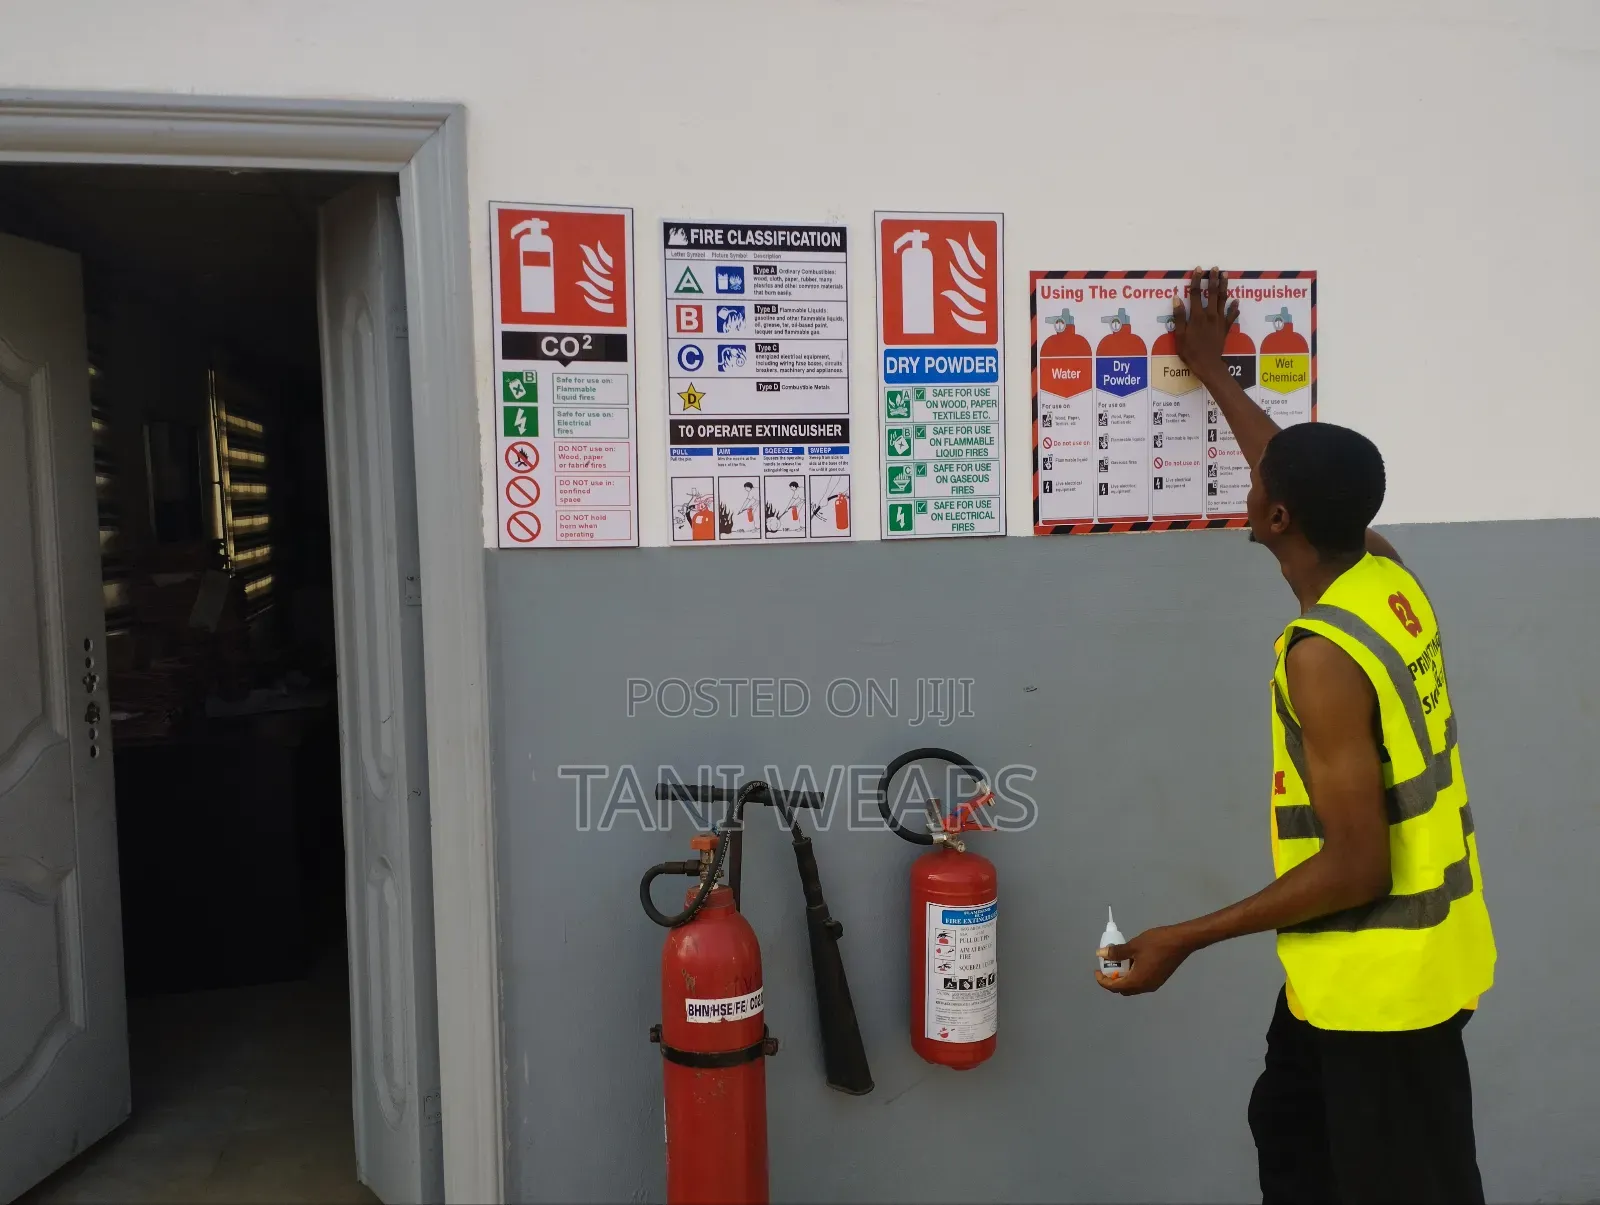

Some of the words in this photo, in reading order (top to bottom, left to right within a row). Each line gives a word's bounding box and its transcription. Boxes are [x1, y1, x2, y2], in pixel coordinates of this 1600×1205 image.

[690, 228, 724, 245] FIRE
[727, 230, 841, 247] CLASSIFICATION
[686, 251, 706, 259] Symbol
[755, 266, 770, 275] Type
[1041, 285, 1084, 302] Using
[1089, 285, 1117, 299] The
[1122, 285, 1178, 299] Correct
[1226, 285, 1308, 302] xtinguisher
[756, 305, 771, 314] Type
[680, 307, 699, 331] B
[757, 344, 772, 352] Type
[772, 344, 778, 352] C
[681, 346, 701, 369] C
[886, 356, 921, 374] DRY
[924, 356, 997, 374] POWDER
[1113, 360, 1131, 374] Dry
[1275, 357, 1293, 369] Wet
[1051, 367, 1081, 380] Water
[1163, 366, 1191, 378] Foam
[1228, 365, 1242, 377] O2
[525, 372, 534, 382] B
[1103, 374, 1141, 387] Powder
[1261, 371, 1306, 383] Chemical
[758, 383, 773, 391] Type
[903, 390, 910, 399] A
[932, 388, 954, 398] SAFE
[955, 388, 972, 397] FOR
[974, 388, 991, 397] USE
[688, 393, 697, 404] D
[925, 400, 939, 409] ON
[940, 400, 969, 410] WOOD,
[970, 399, 998, 408] PAPER
[932, 411, 971, 420] TEXTILES
[972, 411, 991, 420] ETC.
[678, 424, 695, 438] TO
[697, 424, 752, 438] OPERATE
[755, 423, 842, 438] EXTINGUISHER
[904, 428, 911, 436] B
[932, 426, 954, 435] SAFE
[955, 426, 973, 435] FOR
[974, 426, 991, 434] USE
[929, 437, 942, 447] ON
[944, 437, 995, 446] FLAMMABLE
[672, 448, 689, 456] PULL
[935, 448, 964, 458] LIQUID
[965, 448, 989, 457] FIRES
[904, 466, 911, 475] C
[933, 464, 954, 473] SAFE
[956, 464, 973, 472] FOR
[975, 463, 992, 471] USE
[935, 475, 948, 484] ON
[949, 474, 990, 483] GASEOUS
[951, 486, 975, 495] FIRES
[933, 501, 955, 510] SAFE
[956, 500, 974, 509] FOR
[975, 500, 992, 508] USE
[930, 512, 943, 521] ON
[945, 511, 996, 520] ELECTRICAL
[951, 522, 975, 532] FIRES
[559, 531, 595, 539] operating
[945, 917, 962, 925] FIRE
